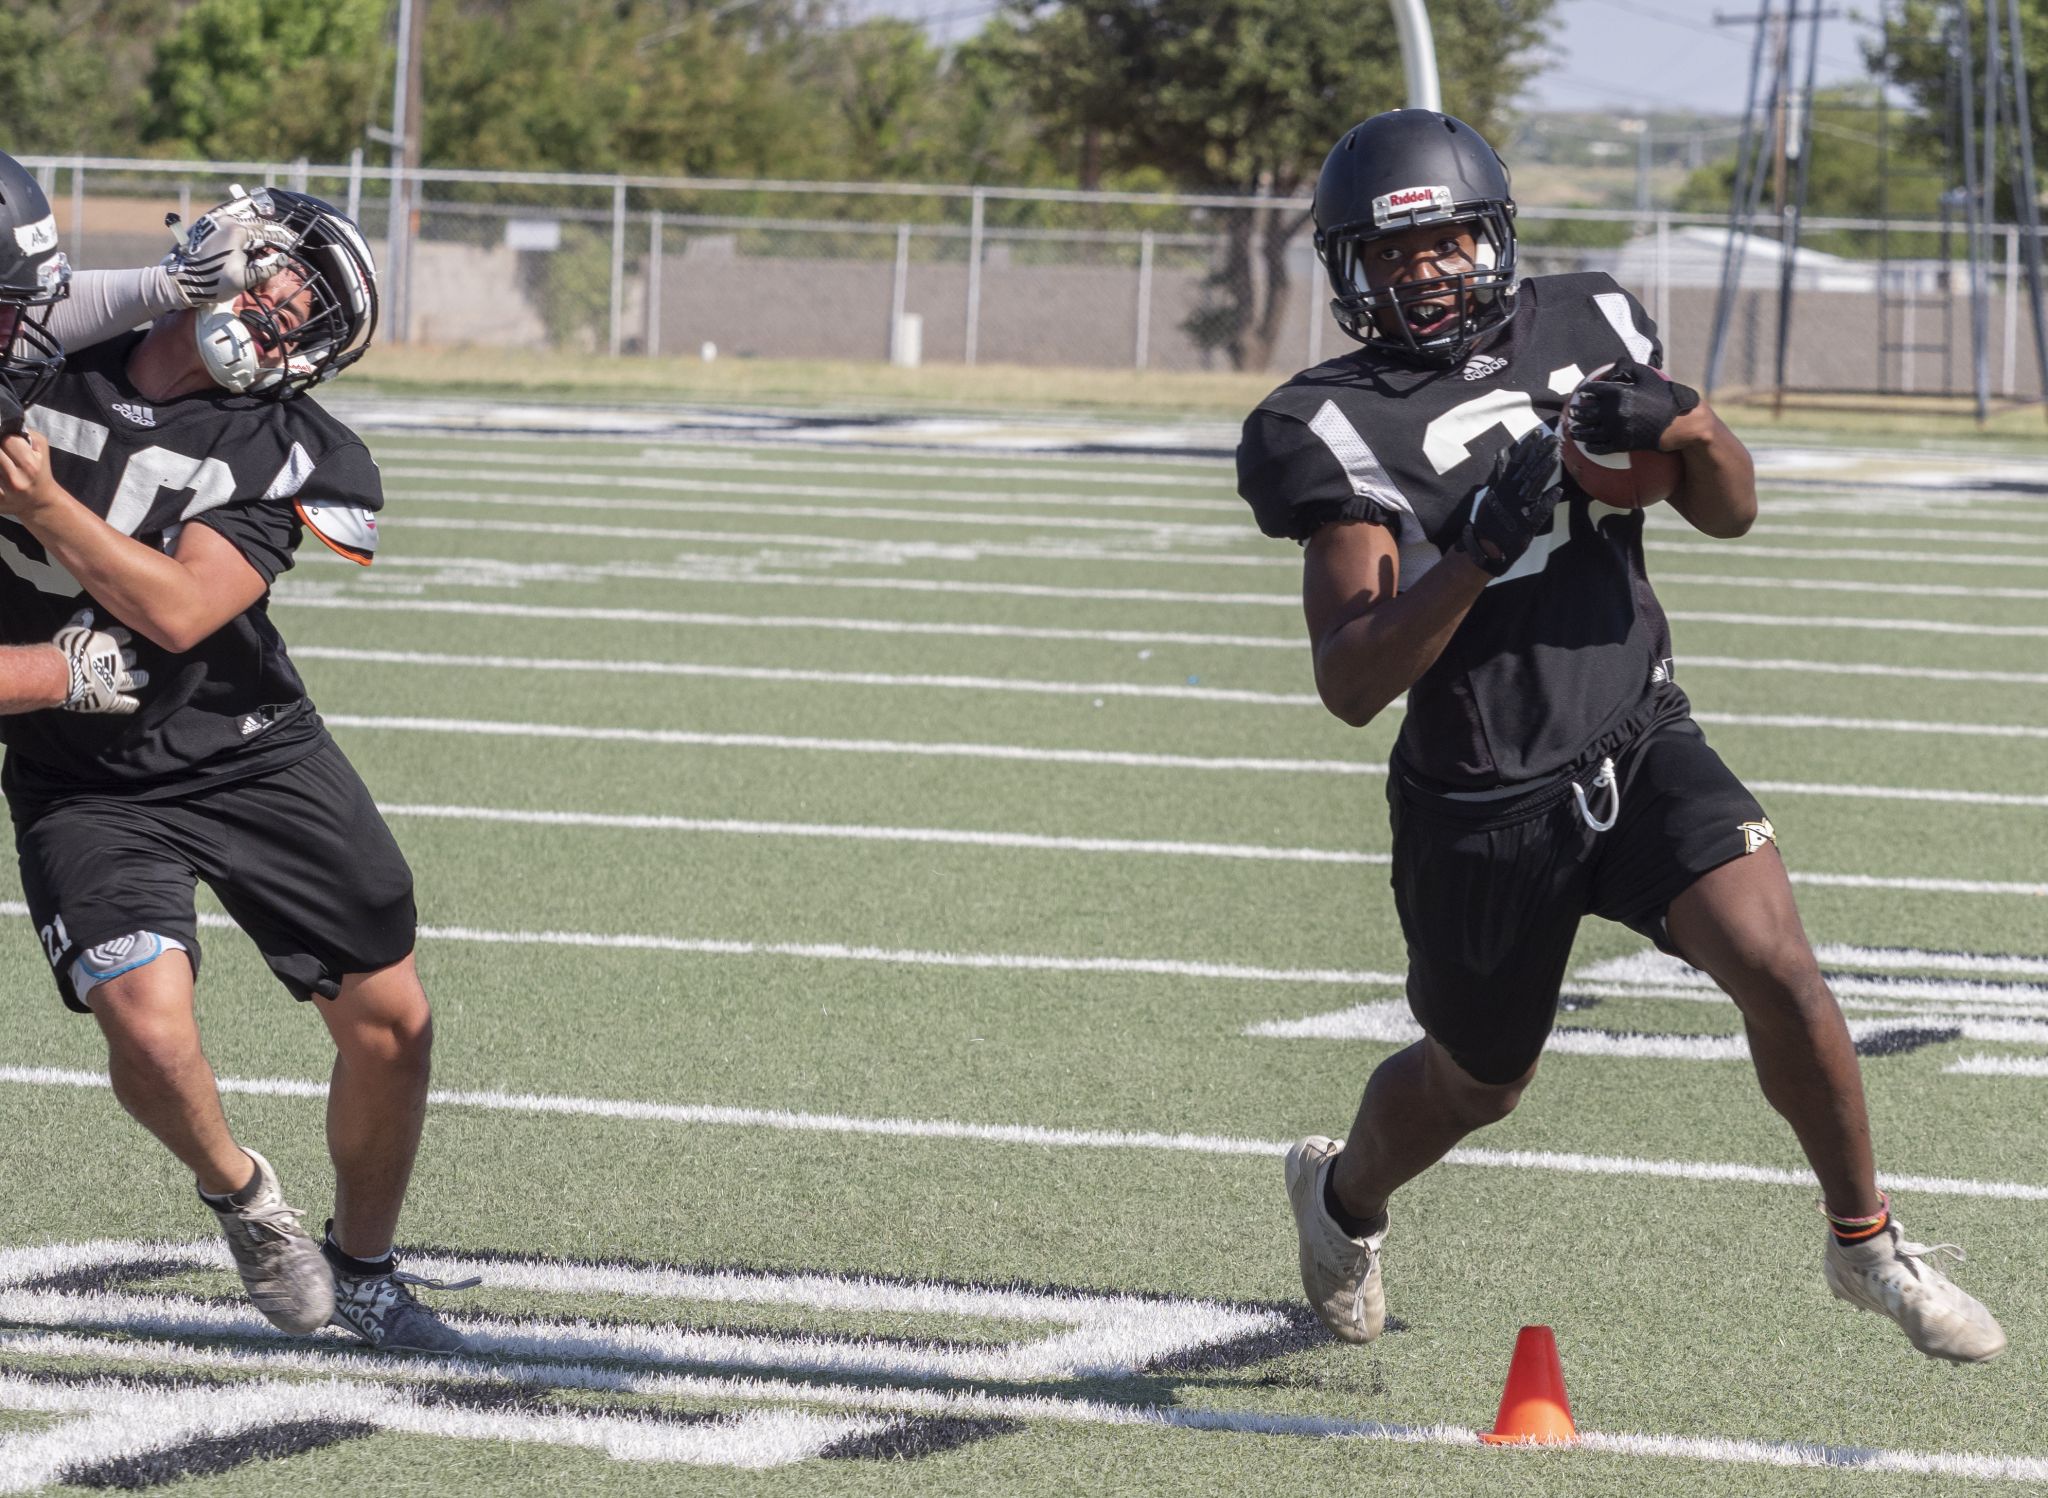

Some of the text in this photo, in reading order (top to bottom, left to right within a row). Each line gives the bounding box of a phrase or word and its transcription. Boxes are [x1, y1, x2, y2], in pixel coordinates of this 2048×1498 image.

[1390, 188, 1433, 206] Riddell
[1463, 357, 1509, 381] adidas
[112, 403, 157, 427] adidas
[41, 914, 73, 967] 21
